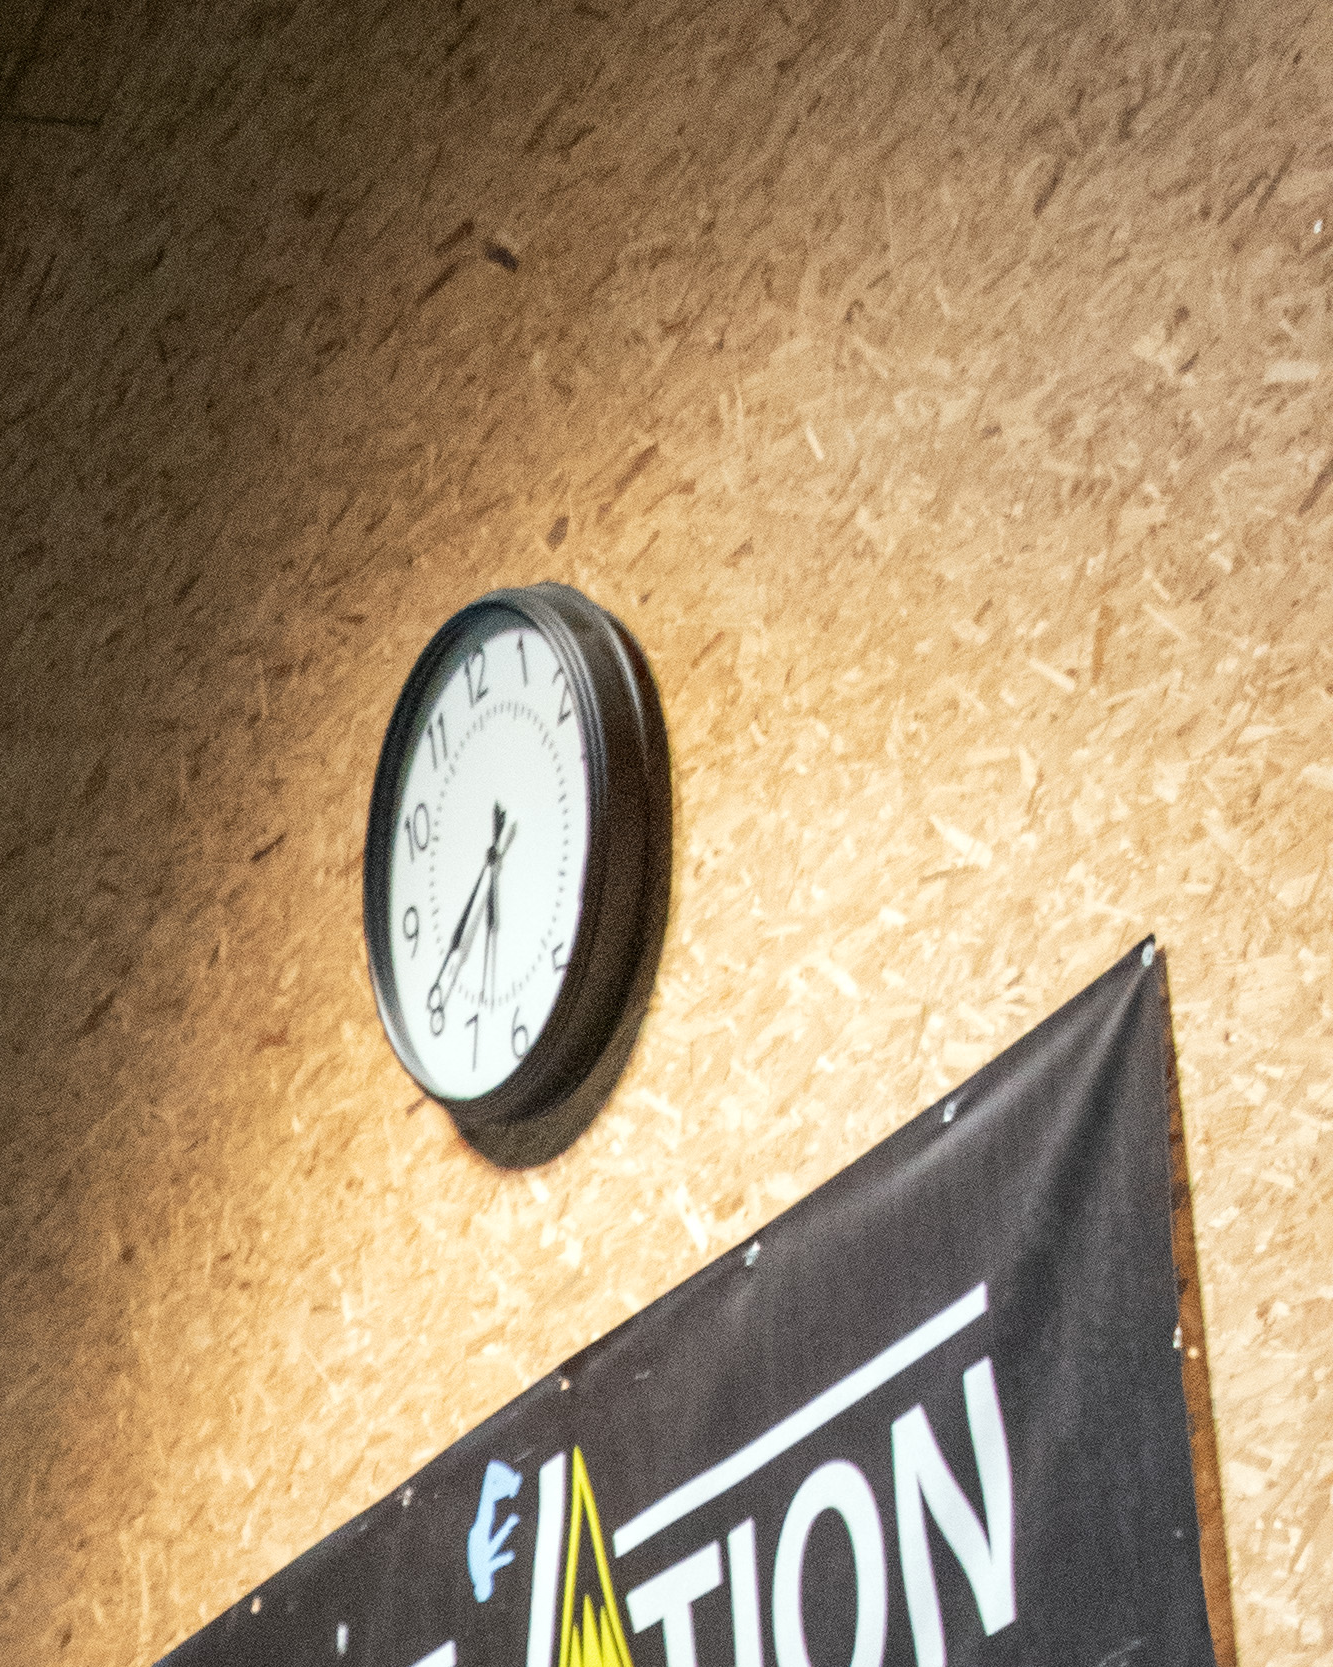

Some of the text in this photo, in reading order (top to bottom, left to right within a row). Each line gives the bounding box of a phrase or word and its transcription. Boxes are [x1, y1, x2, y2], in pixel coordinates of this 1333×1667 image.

[463, 640, 491, 708] 12
[427, 710, 450, 771] 11
[404, 800, 431, 863] 10
[402, 904, 422, 959] 9
[425, 982, 447, 1037] 8
[510, 1005, 529, 1060] 6
[464, 1011, 479, 1073] 7
